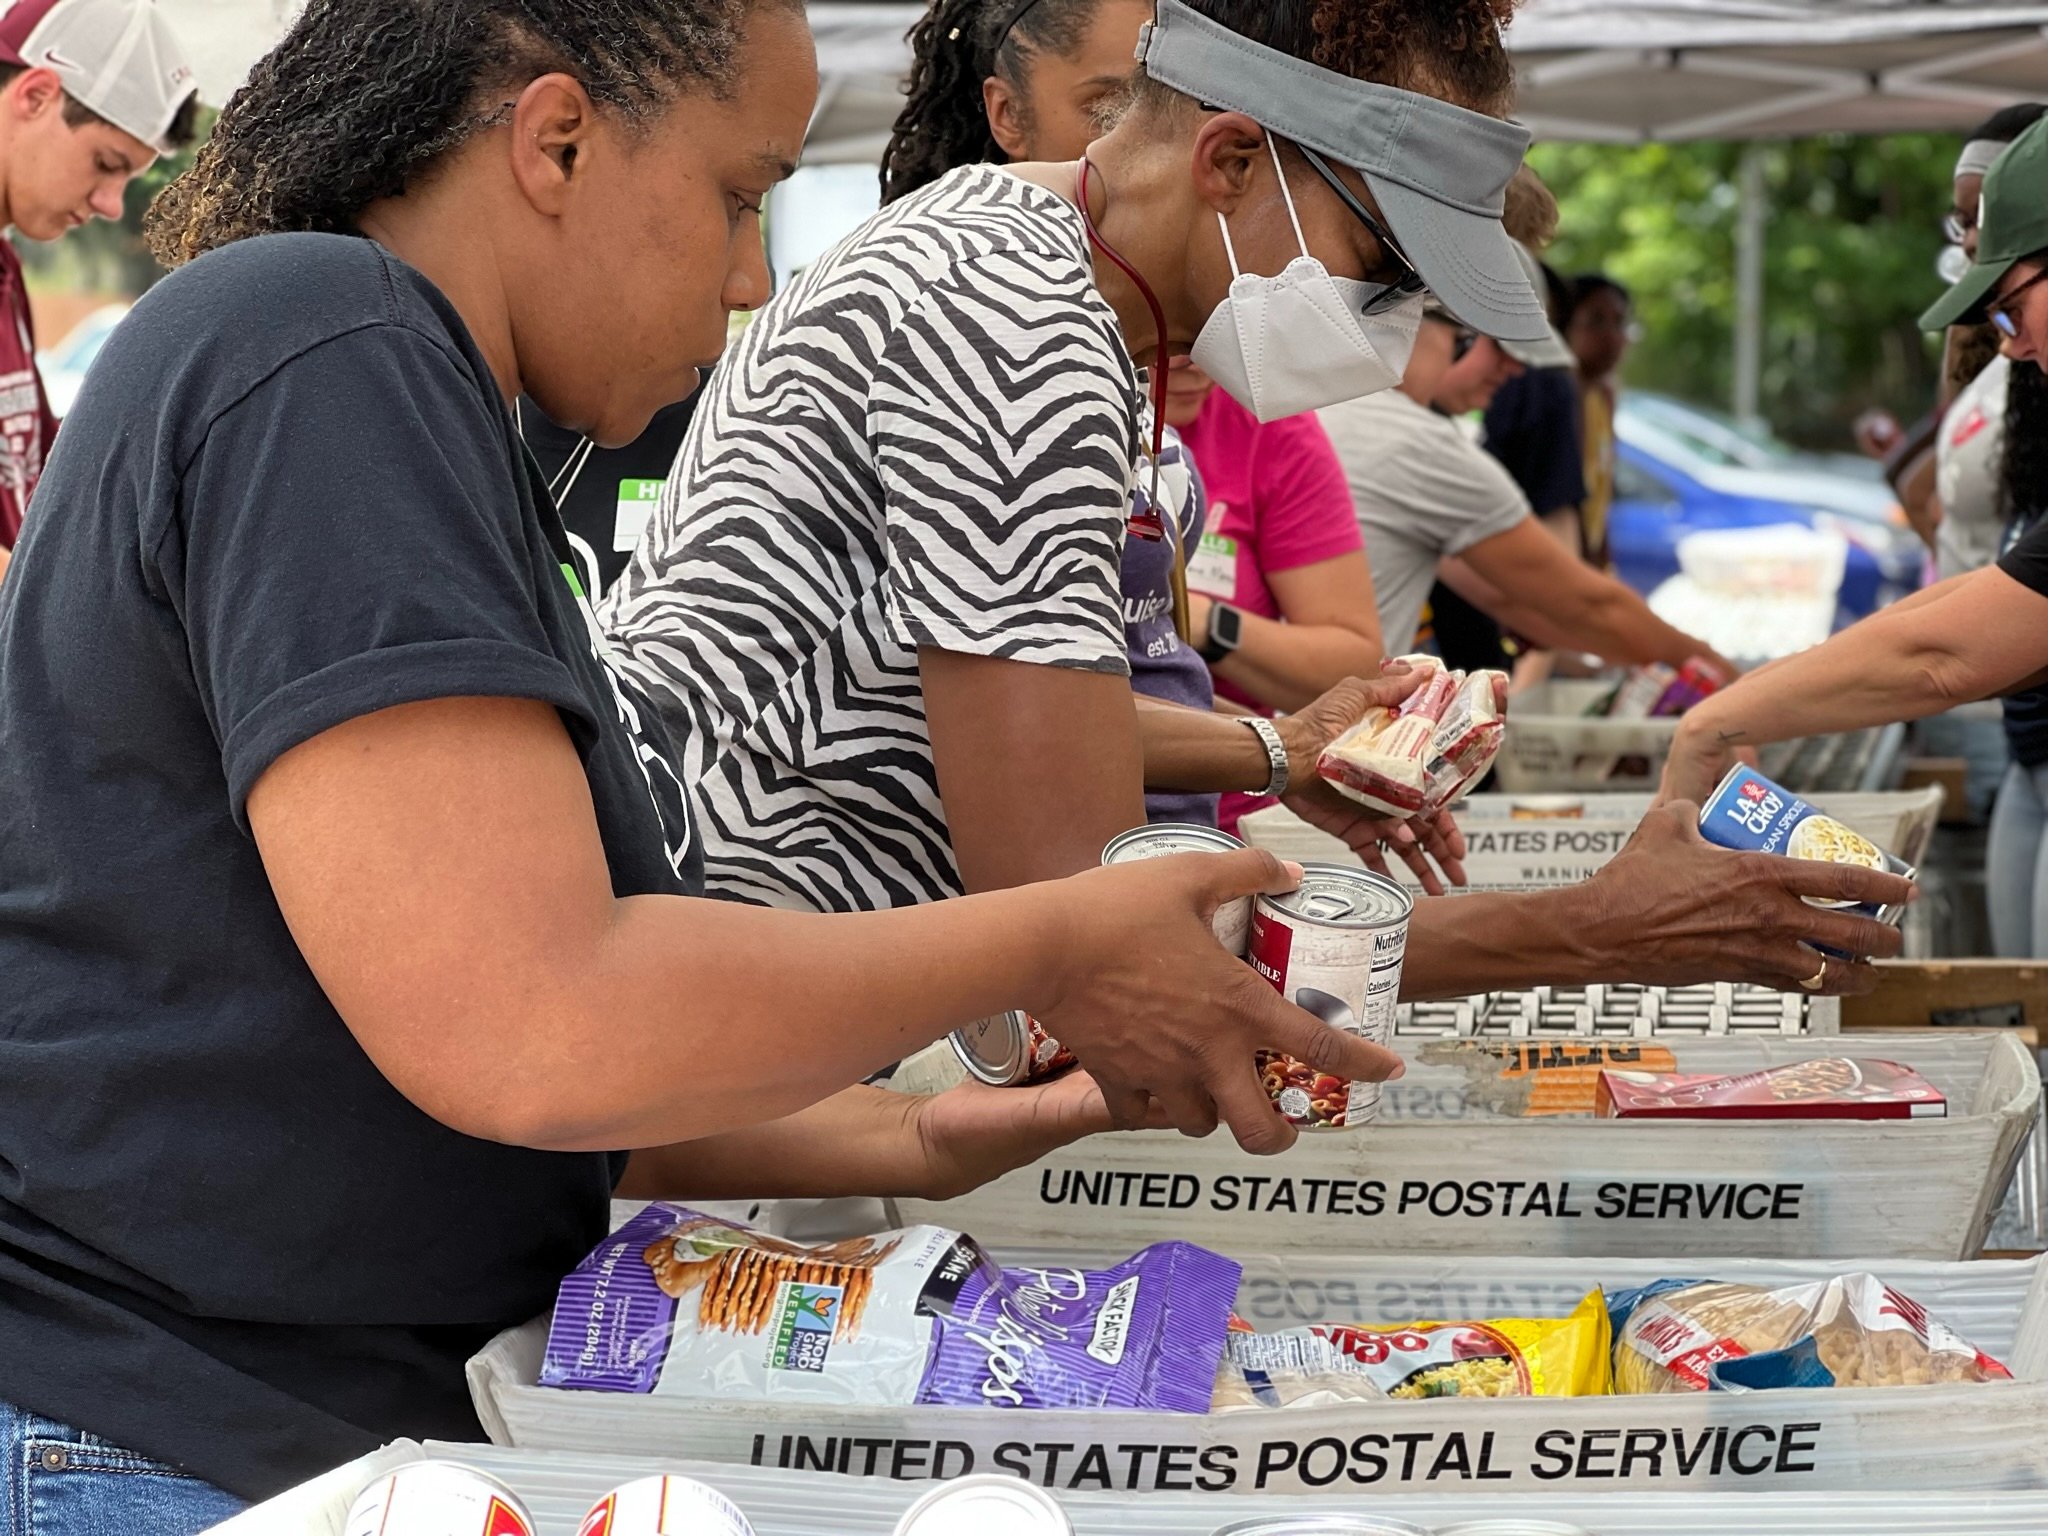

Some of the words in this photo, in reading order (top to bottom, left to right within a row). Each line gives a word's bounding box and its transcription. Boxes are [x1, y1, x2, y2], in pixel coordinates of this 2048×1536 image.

[1727, 797, 1757, 825] LA
[1746, 791, 1784, 834] CHOY
[1466, 831, 1547, 853] TATES
[1554, 831, 1626, 853] POST
[1521, 867, 1594, 880] WARNIN
[1368, 979, 1391, 992] Calories
[1041, 1169, 1200, 1209] UNITED
[1210, 1176, 1386, 1217] STATES
[1398, 1181, 1583, 1218] POSTAL
[1594, 1183, 1803, 1220] SERVICE
[599, 1259, 617, 1275] WT
[610, 1242, 629, 1257] NET
[594, 1279, 609, 1297] 7.2
[590, 1301, 605, 1319] OZ
[762, 1283, 789, 1369] nongmoproject.org
[774, 1289, 801, 1366] VERIFIED
[580, 1323, 600, 1367] (204g)
[788, 1331, 804, 1368] Project
[798, 1332, 815, 1368] GMO
[809, 1334, 830, 1369] NON
[751, 1434, 975, 1481] UNITED
[993, 1441, 1239, 1492] STATES
[1256, 1431, 1511, 1490] POSTAL
[1531, 1422, 1822, 1479] SERVICE
